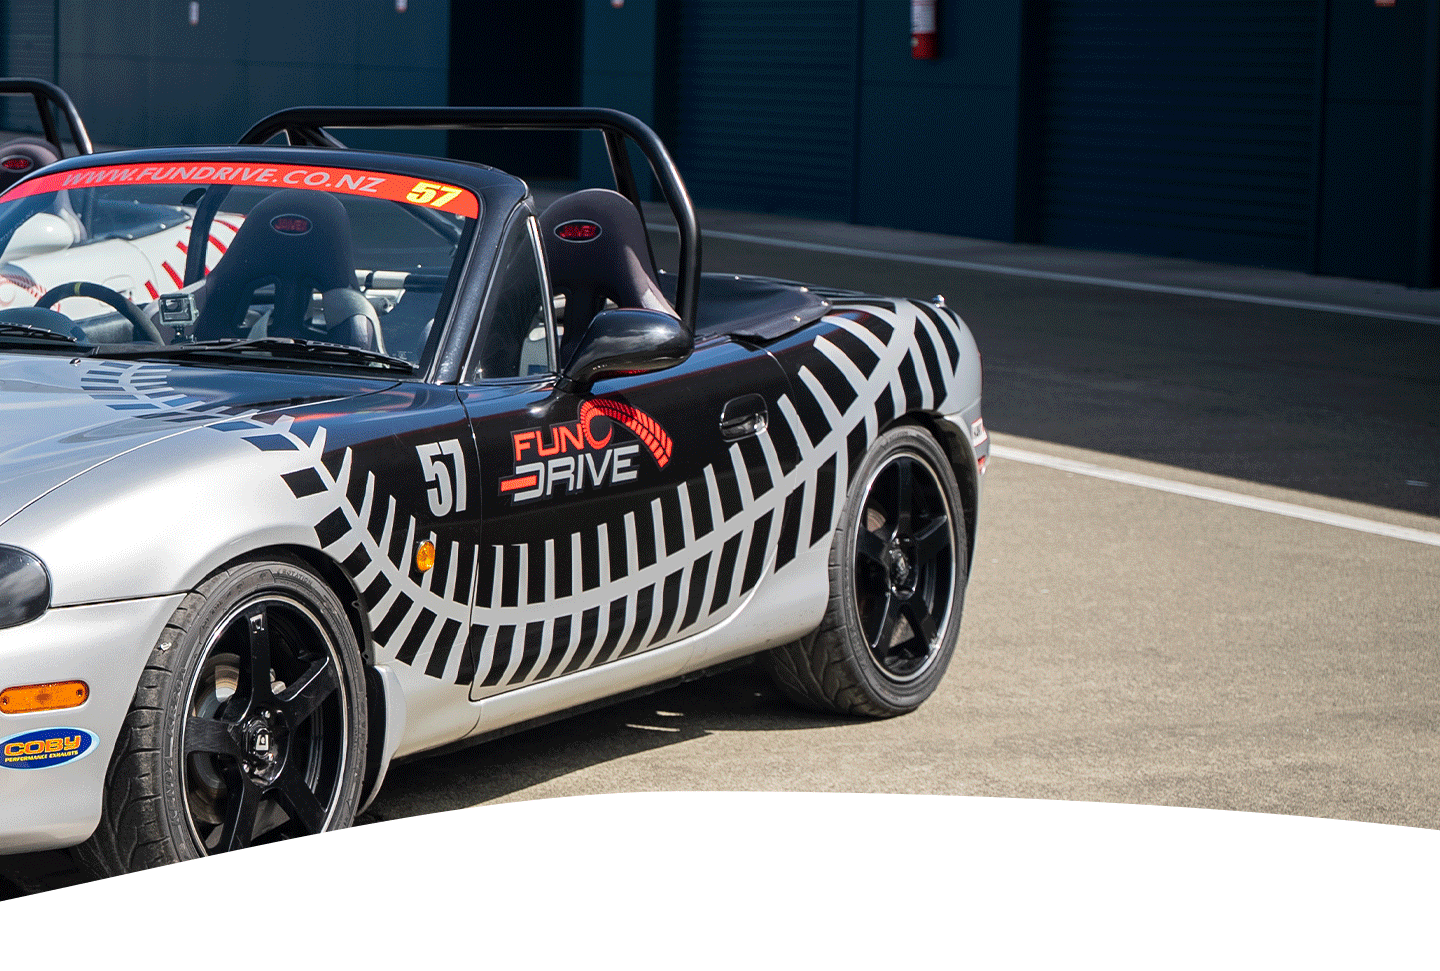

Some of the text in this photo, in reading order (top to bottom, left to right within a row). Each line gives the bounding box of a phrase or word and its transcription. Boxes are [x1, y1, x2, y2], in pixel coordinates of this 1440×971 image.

[63, 166, 386, 193] WWW.FUNDRIVE.CO.NZ
[406, 181, 463, 208] 57
[416, 438, 467, 517] 57
[500, 444, 640, 502] DRIVE
[4, 735, 81, 757] COBY
